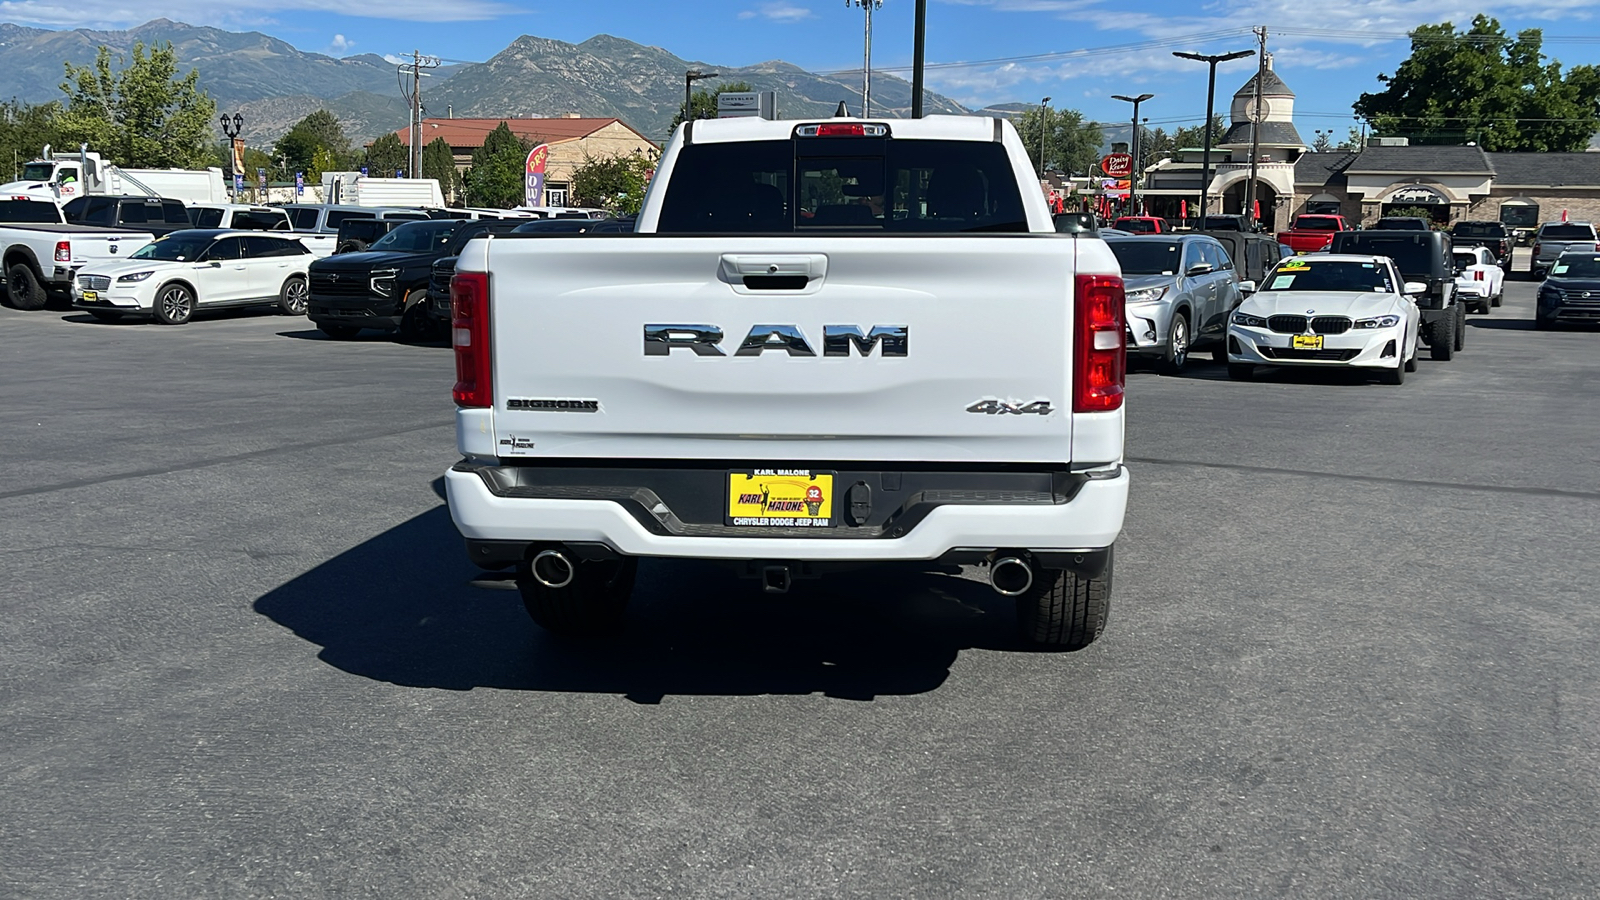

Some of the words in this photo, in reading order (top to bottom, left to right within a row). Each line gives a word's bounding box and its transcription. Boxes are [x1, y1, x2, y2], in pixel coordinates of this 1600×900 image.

[529, 148, 546, 172] PRE
[1109, 156, 1130, 168] Dairy
[643, 324, 908, 357] RAM
[506, 397, 599, 413] BIGHORN
[808, 489, 820, 498] 32
[738, 493, 763, 504] KARL
[767, 500, 805, 512] MALONE
[733, 517, 769, 526] CHRYSLER
[770, 517, 794, 526] DODGE
[795, 518, 812, 526] JEEP
[812, 518, 828, 527] RAM
